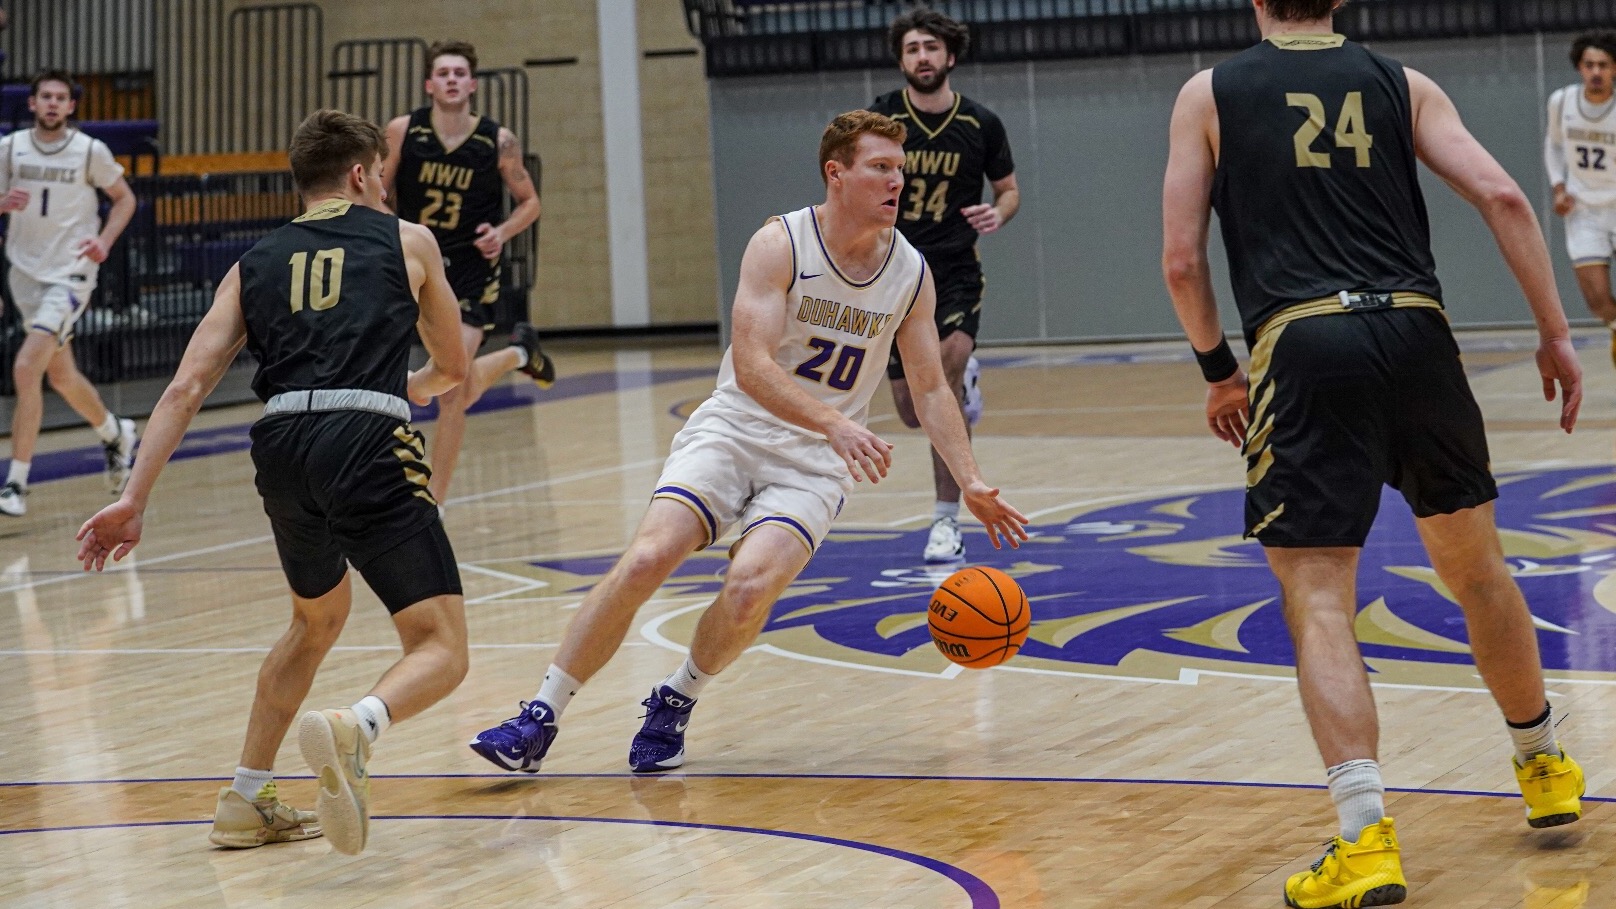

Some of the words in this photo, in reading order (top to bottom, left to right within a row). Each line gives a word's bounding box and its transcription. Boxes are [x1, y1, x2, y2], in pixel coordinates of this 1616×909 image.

[1285, 91, 1373, 169] 24
[418, 161, 474, 191] NWU
[904, 150, 960, 176] NWU
[1576, 146, 1607, 170] 32
[41, 187, 49, 217] 1
[419, 188, 462, 230] 23
[903, 178, 950, 222] 34
[288, 247, 345, 315] 10
[793, 336, 866, 392] 20
